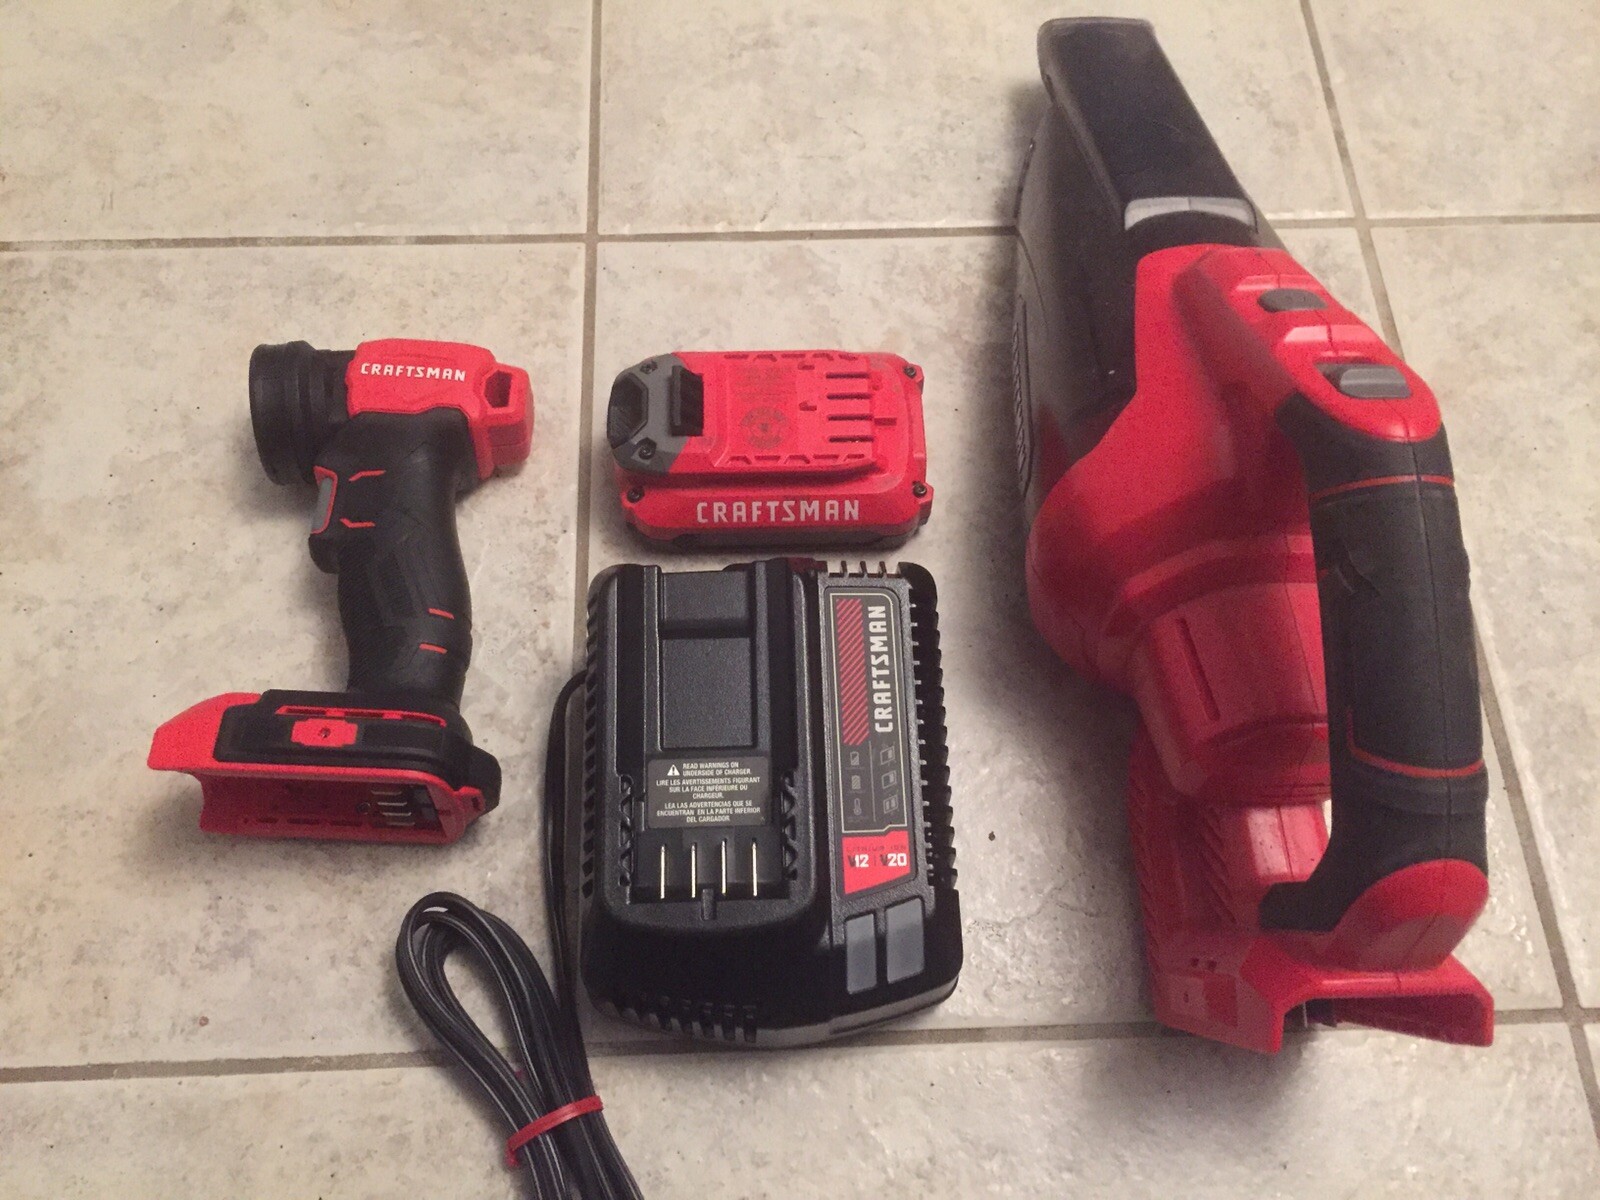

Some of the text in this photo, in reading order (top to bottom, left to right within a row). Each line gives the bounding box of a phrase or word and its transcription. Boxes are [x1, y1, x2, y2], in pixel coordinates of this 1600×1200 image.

[361, 362, 466, 382] CRAFTSMAN
[696, 500, 860, 524] CRAFTSMAN
[868, 606, 893, 733] CRAFTSMAN
[682, 778, 732, 786] AVERTISSEMENTS
